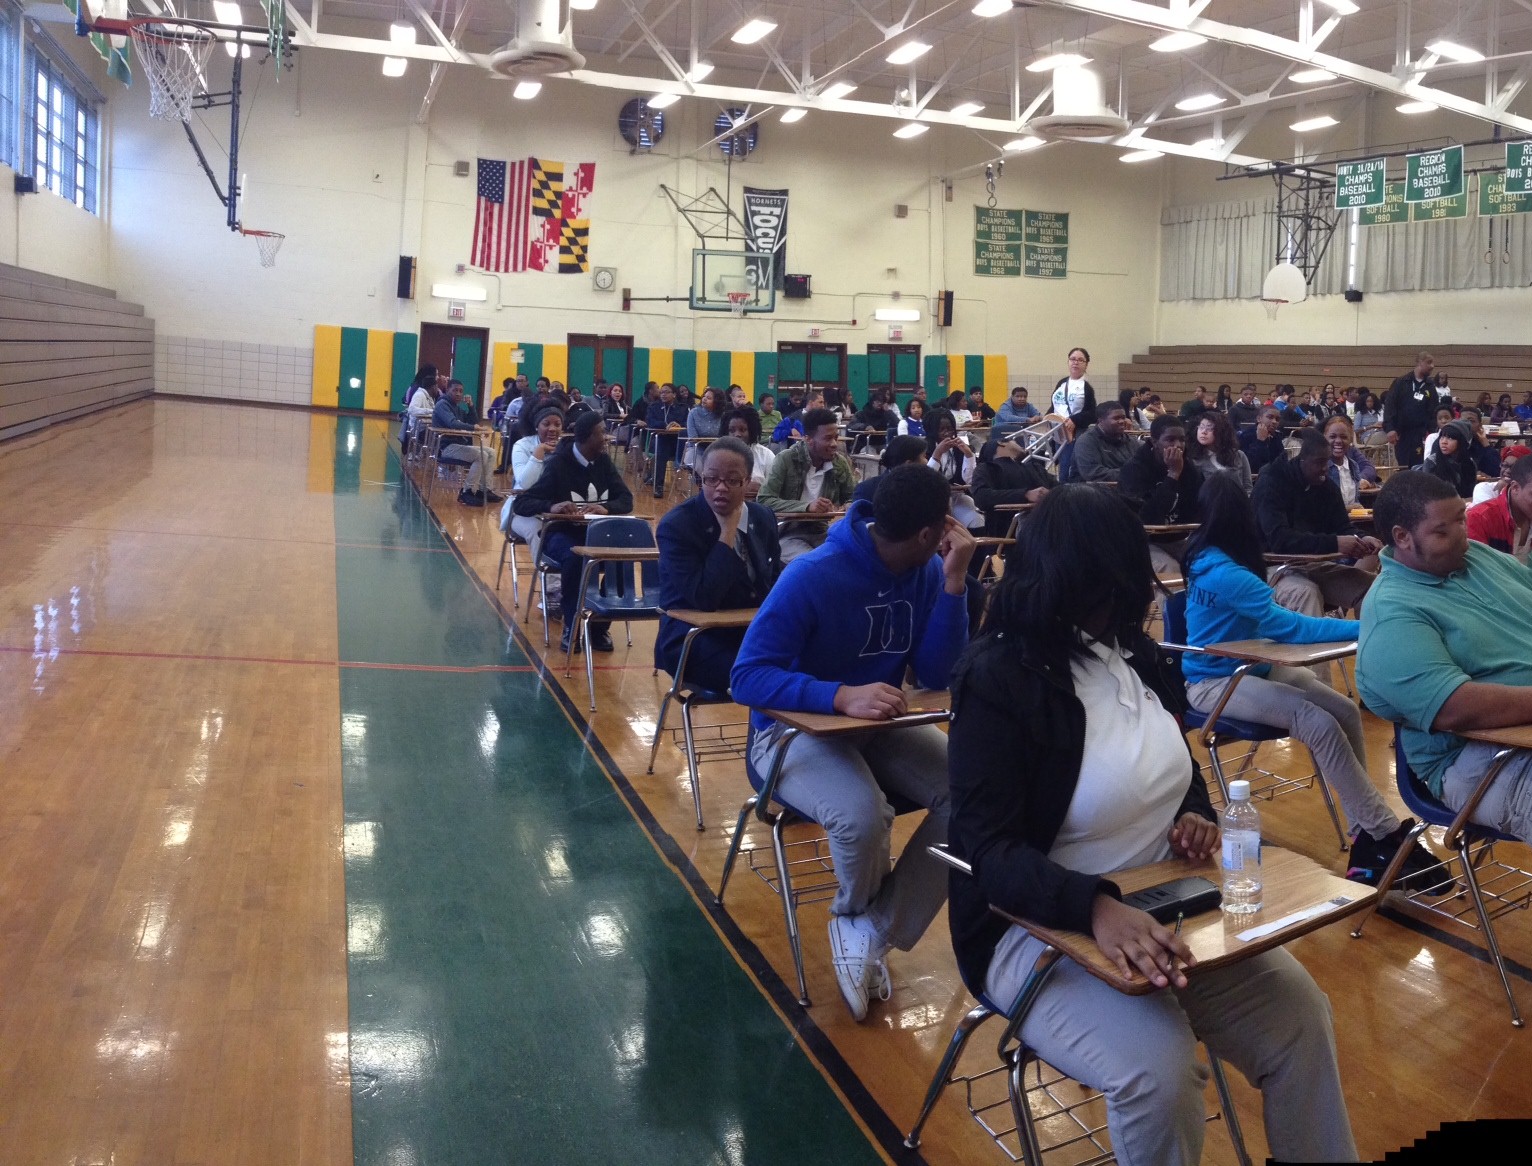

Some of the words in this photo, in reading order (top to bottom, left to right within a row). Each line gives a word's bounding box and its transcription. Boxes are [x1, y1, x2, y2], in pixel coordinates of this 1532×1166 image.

[1420, 153, 1445, 166] REGION
[1418, 164, 1446, 176] CHAMPS
[1507, 168, 1522, 178] BOYS
[1345, 173, 1372, 185] CHAMPS
[1413, 174, 1450, 188] BASEBALL
[1340, 183, 1375, 196] BASEBALL
[1424, 187, 1441, 197] 2010
[1349, 195, 1366, 205] 2010
[1489, 193, 1526, 203] SOFTBALL
[1422, 198, 1457, 209] SOFTBALL
[1367, 204, 1399, 214] SOFTBALL
[982, 217, 1015, 225] CHAMPIONS
[1031, 220, 1063, 228] CHAMPIONS
[981, 251, 1014, 259] CHAMPIONS
[1030, 253, 1062, 261] CHAMPIONS
